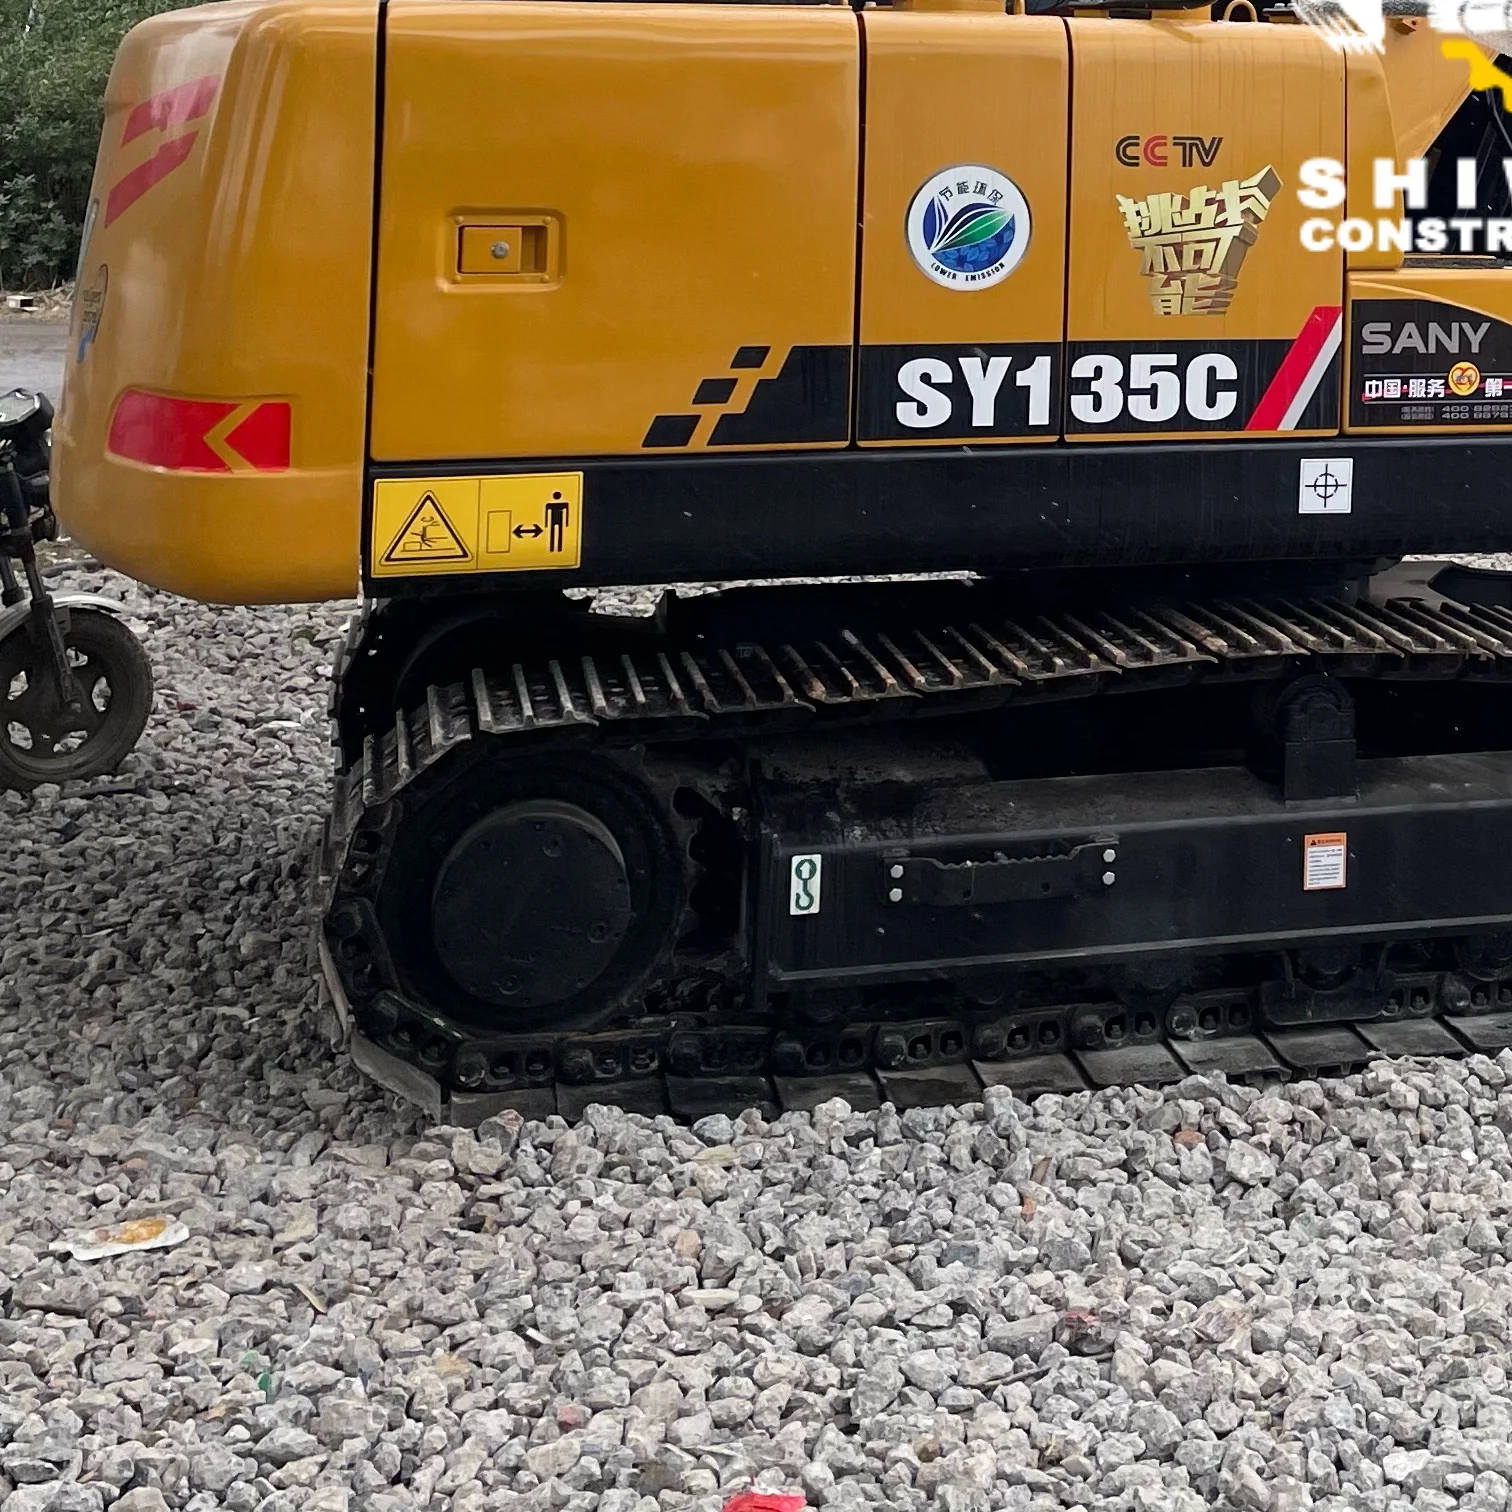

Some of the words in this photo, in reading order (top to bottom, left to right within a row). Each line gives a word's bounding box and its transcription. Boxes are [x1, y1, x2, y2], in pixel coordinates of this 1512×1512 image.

[1115, 135, 1224, 168] CCTV
[938, 180, 1004, 205] 节能环保
[1115, 164, 1284, 238] 挑战
[1130, 224, 1258, 276] 不可
[930, 262, 957, 281] LOWER
[964, 261, 1006, 282] EMISSION
[1149, 272, 1238, 315] 能
[1361, 322, 1491, 355] SANY
[896, 353, 1238, 429] SY135C
